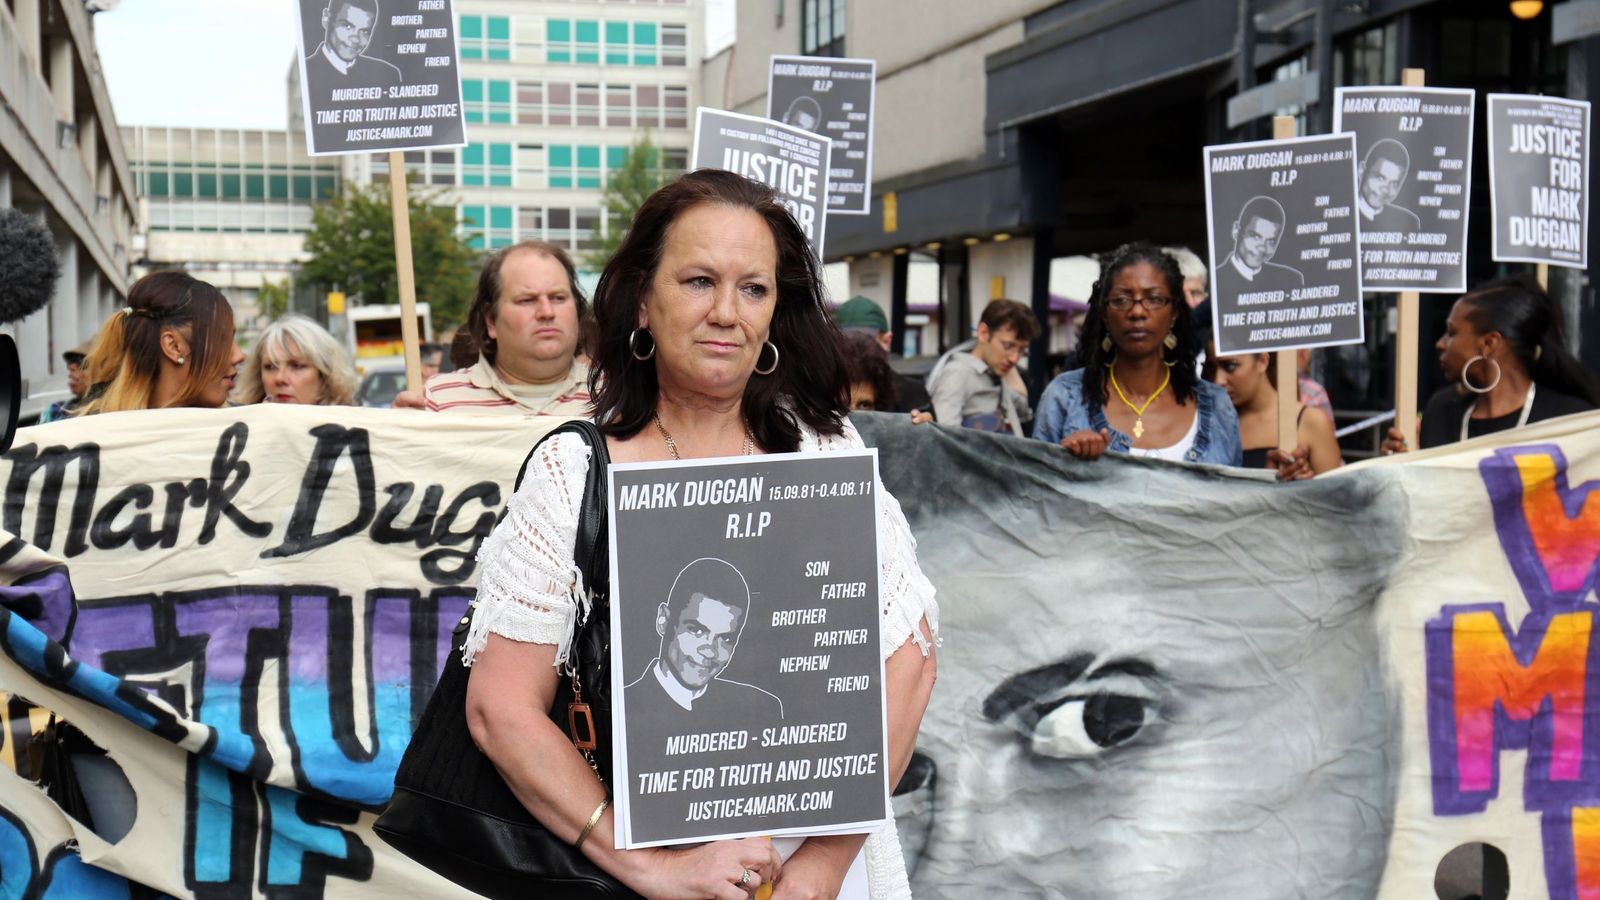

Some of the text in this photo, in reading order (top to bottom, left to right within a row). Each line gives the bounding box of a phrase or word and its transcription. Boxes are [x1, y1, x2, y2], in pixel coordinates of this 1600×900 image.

[416, 28, 447, 39] PARTNER
[425, 56, 450, 67] FRIEND
[332, 87, 382, 101] MURDERED
[389, 84, 438, 98] SLANDERED
[316, 103, 458, 125] TIME FOR TRUTH AND JUSTICE
[1343, 98, 1378, 113] MARK
[1378, 98, 1421, 113] DUGGAN
[1399, 116, 1423, 131] R.I.P
[345, 125, 432, 142] JUSTICE4MARK.COM
[1510, 123, 1582, 160] JUSTICE
[1212, 155, 1245, 172] MARK
[1247, 150, 1293, 170] DUGGAN
[722, 147, 818, 202] JUSTICE
[1270, 170, 1297, 187] R.I.P
[1550, 157, 1581, 190] FOR
[1315, 196, 1330, 206] SON
[1531, 186, 1581, 221] MARK
[772, 197, 814, 240] OR
[1323, 206, 1350, 219] FATHER
[1296, 222, 1328, 235] BROTHER
[1510, 216, 1580, 251] DUGGAN
[1320, 233, 1351, 245] PARTNER
[1407, 233, 1447, 245] SLANDERED
[1327, 259, 1352, 270] FRIEND
[1363, 250, 1383, 264] FOR
[1384, 251, 1413, 264] TRUTH
[1413, 251, 1429, 264] AND
[1429, 252, 1461, 265] JUSTICE
[1238, 290, 1284, 306] MURDERED
[1291, 285, 1339, 300] SLANDERED
[1223, 302, 1357, 327] TIME FOR TRUTH AND JUSTICE
[1249, 323, 1332, 342] JUSTICE4MARK.COM
[0, 421, 501, 584] Mark Dug
[619, 477, 872, 511] MARK DUGGAN 15.09.81-0.4.08.11
[726, 511, 772, 539] R.I.P
[805, 560, 830, 577] SON
[821, 582, 866, 600] FATHER
[772, 608, 826, 626] BROTHER
[814, 629, 868, 647] PARTNER
[780, 655, 830, 673] NEPHEW
[828, 676, 869, 692] FRIEND
[666, 730, 748, 756] MURDERED
[761, 723, 847, 748] SLANDERED
[638, 753, 878, 794] TIME FOR TRUTH AND JUSTICE
[685, 790, 833, 822] JUSTICE4MARK.COM
